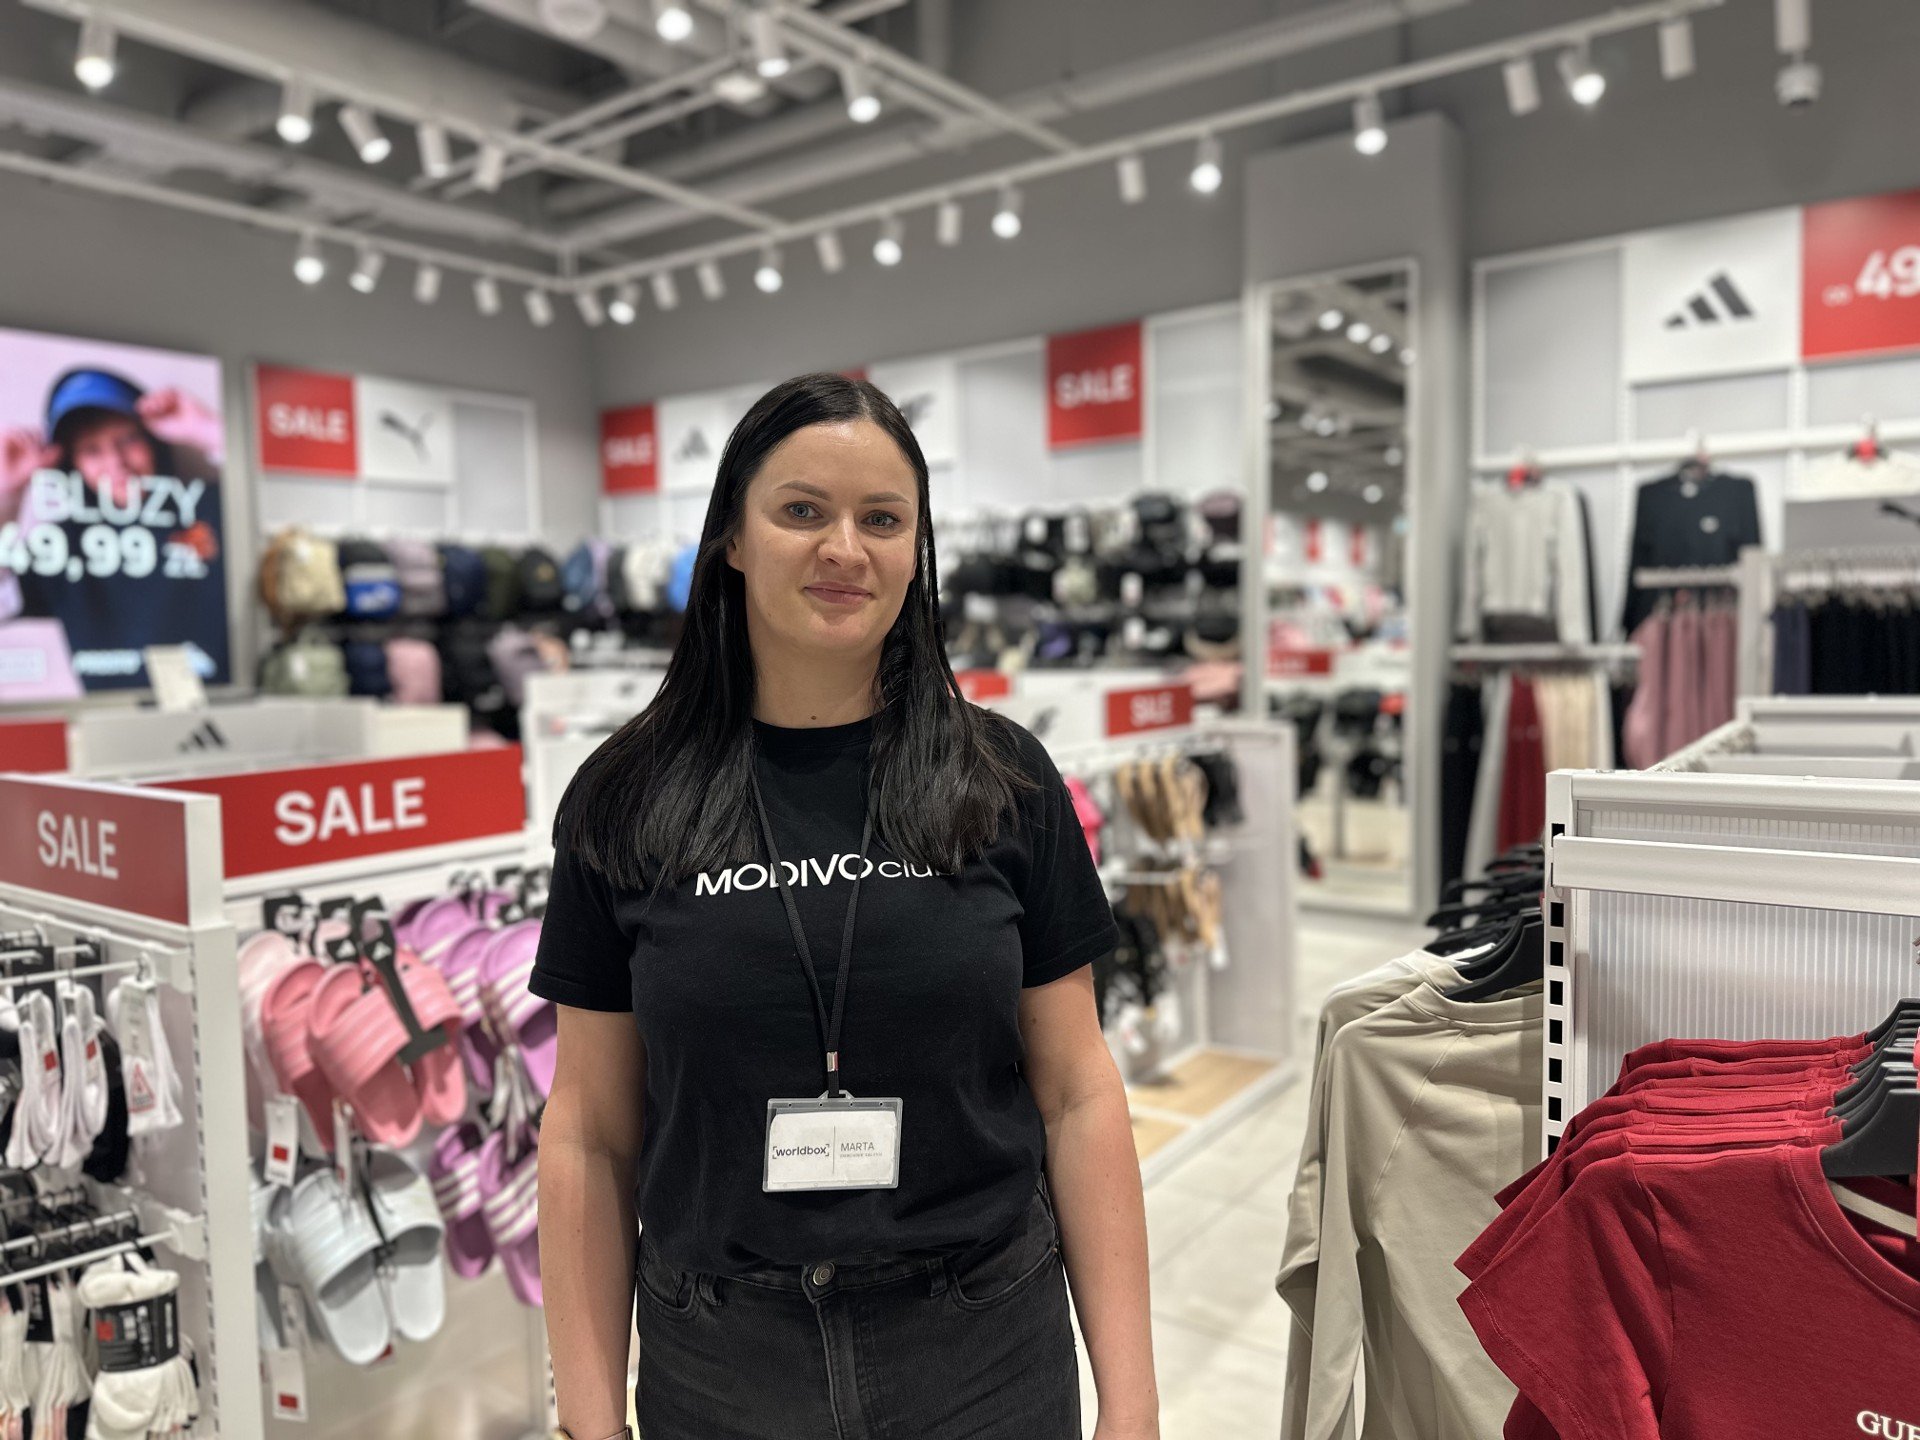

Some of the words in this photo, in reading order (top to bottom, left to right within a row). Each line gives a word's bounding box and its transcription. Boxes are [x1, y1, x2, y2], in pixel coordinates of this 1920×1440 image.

[1055, 364, 1134, 408] SALE
[267, 402, 349, 445] SALE
[31, 468, 205, 528] BLUZY
[275, 778, 427, 846] SALE
[37, 810, 119, 880] SALE
[695, 853, 874, 896] MODIVO
[878, 858, 954, 879] clu
[840, 1141, 875, 1152] MARTA
